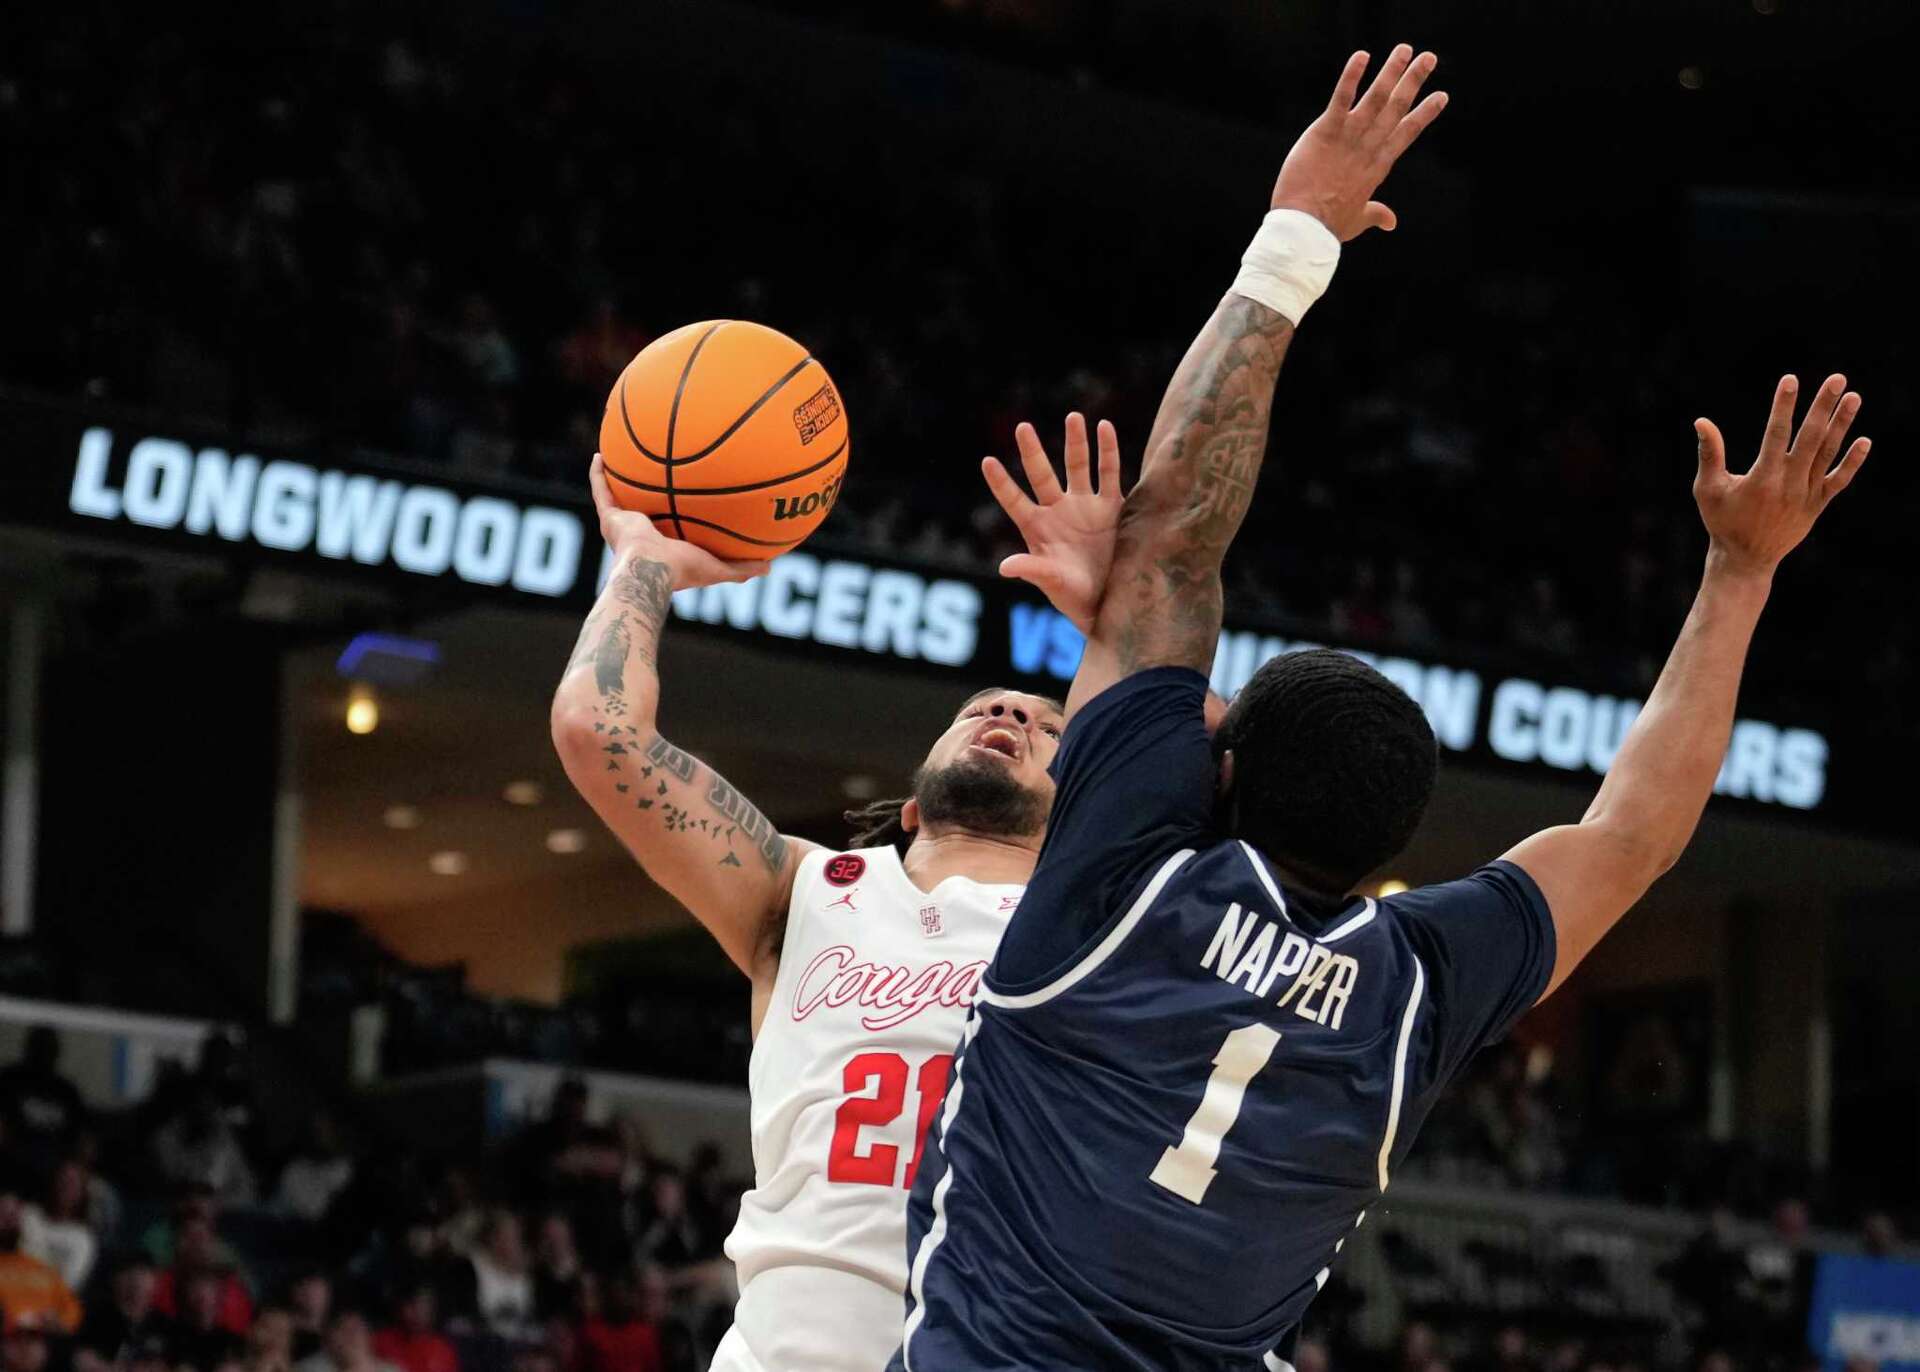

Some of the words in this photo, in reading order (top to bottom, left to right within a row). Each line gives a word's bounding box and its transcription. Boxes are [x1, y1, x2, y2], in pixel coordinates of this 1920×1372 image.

[69, 427, 585, 597] LONGWOOD
[597, 540, 981, 667] NCERS
[1010, 602, 1088, 680] VS
[1487, 677, 1830, 810] COURS
[830, 860, 859, 881] 32
[791, 945, 991, 1032] Couga
[1199, 901, 1359, 1031] NAPPER
[827, 1052, 955, 1191] 21
[1148, 1022, 1282, 1205] 1
